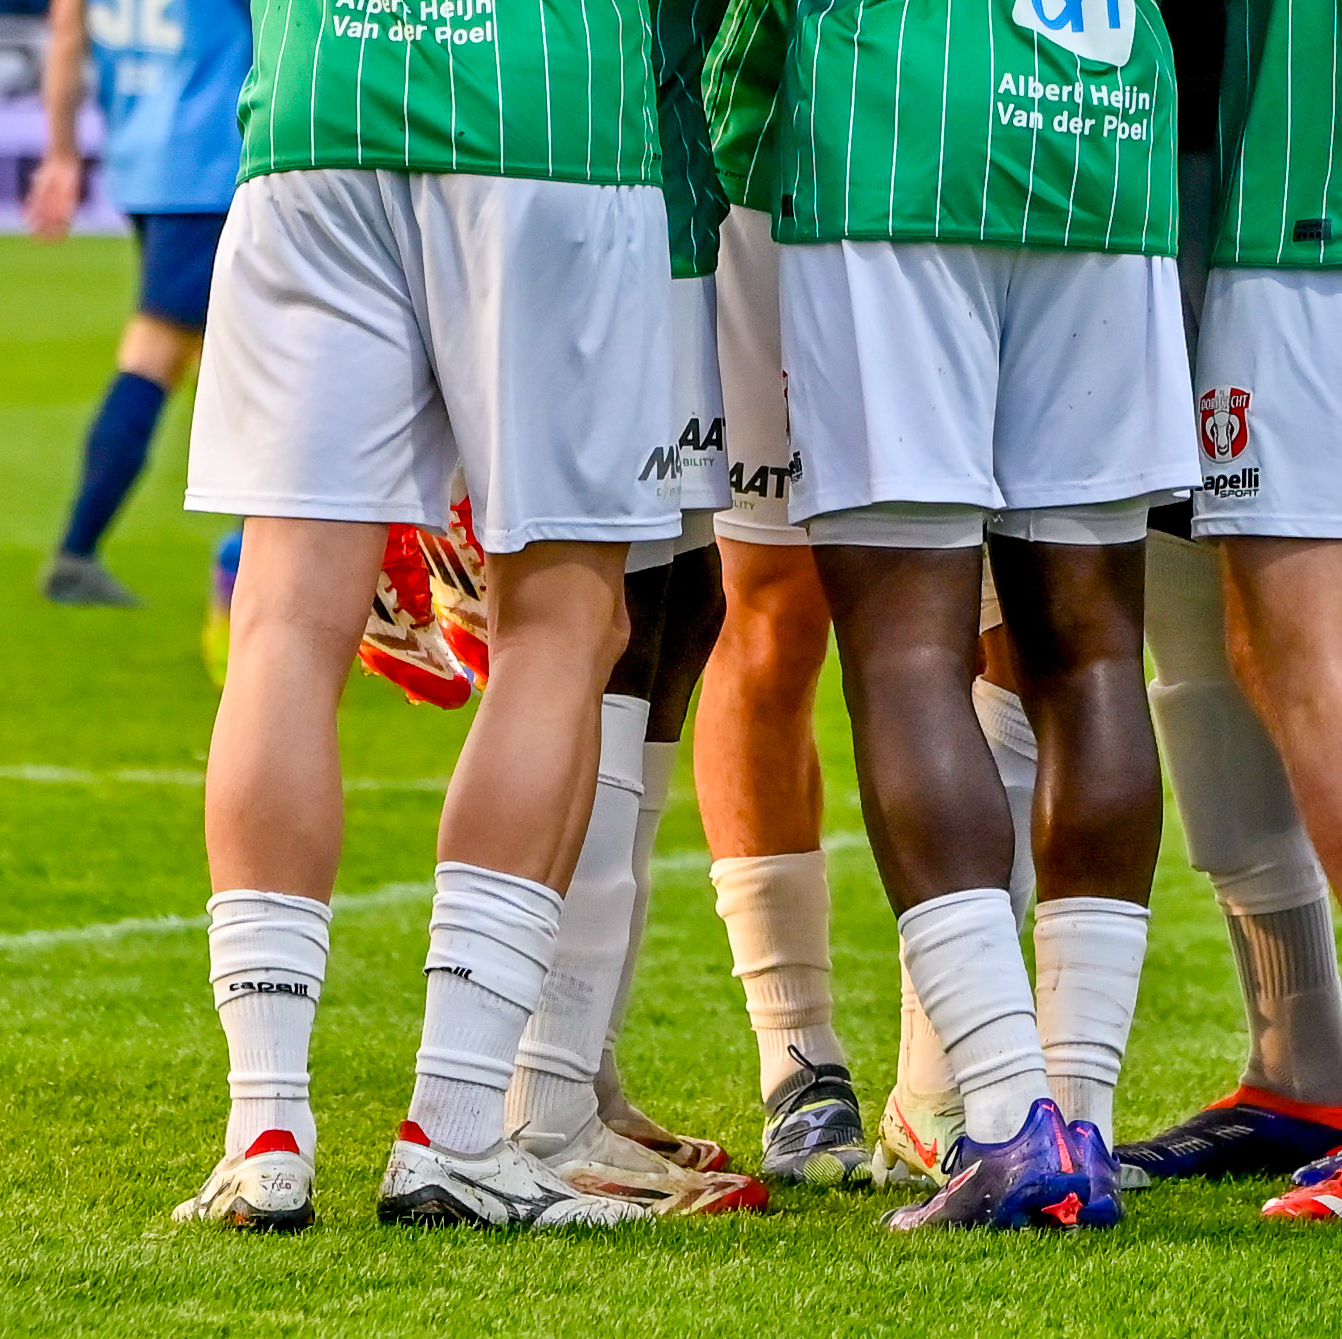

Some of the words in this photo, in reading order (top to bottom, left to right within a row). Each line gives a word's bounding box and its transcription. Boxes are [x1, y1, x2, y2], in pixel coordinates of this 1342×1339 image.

[333, 14, 379, 39] Van
[388, 19, 428, 42] der
[434, 20, 493, 45] Poel
[997, 72, 1084, 104] Albert
[1089, 84, 1150, 115] Heijn
[997, 101, 1044, 130] Van
[1052, 110, 1096, 136] der
[1102, 114, 1148, 141] Poel
[679, 417, 726, 451] AA
[1219, 488, 1260, 499] SPORT
